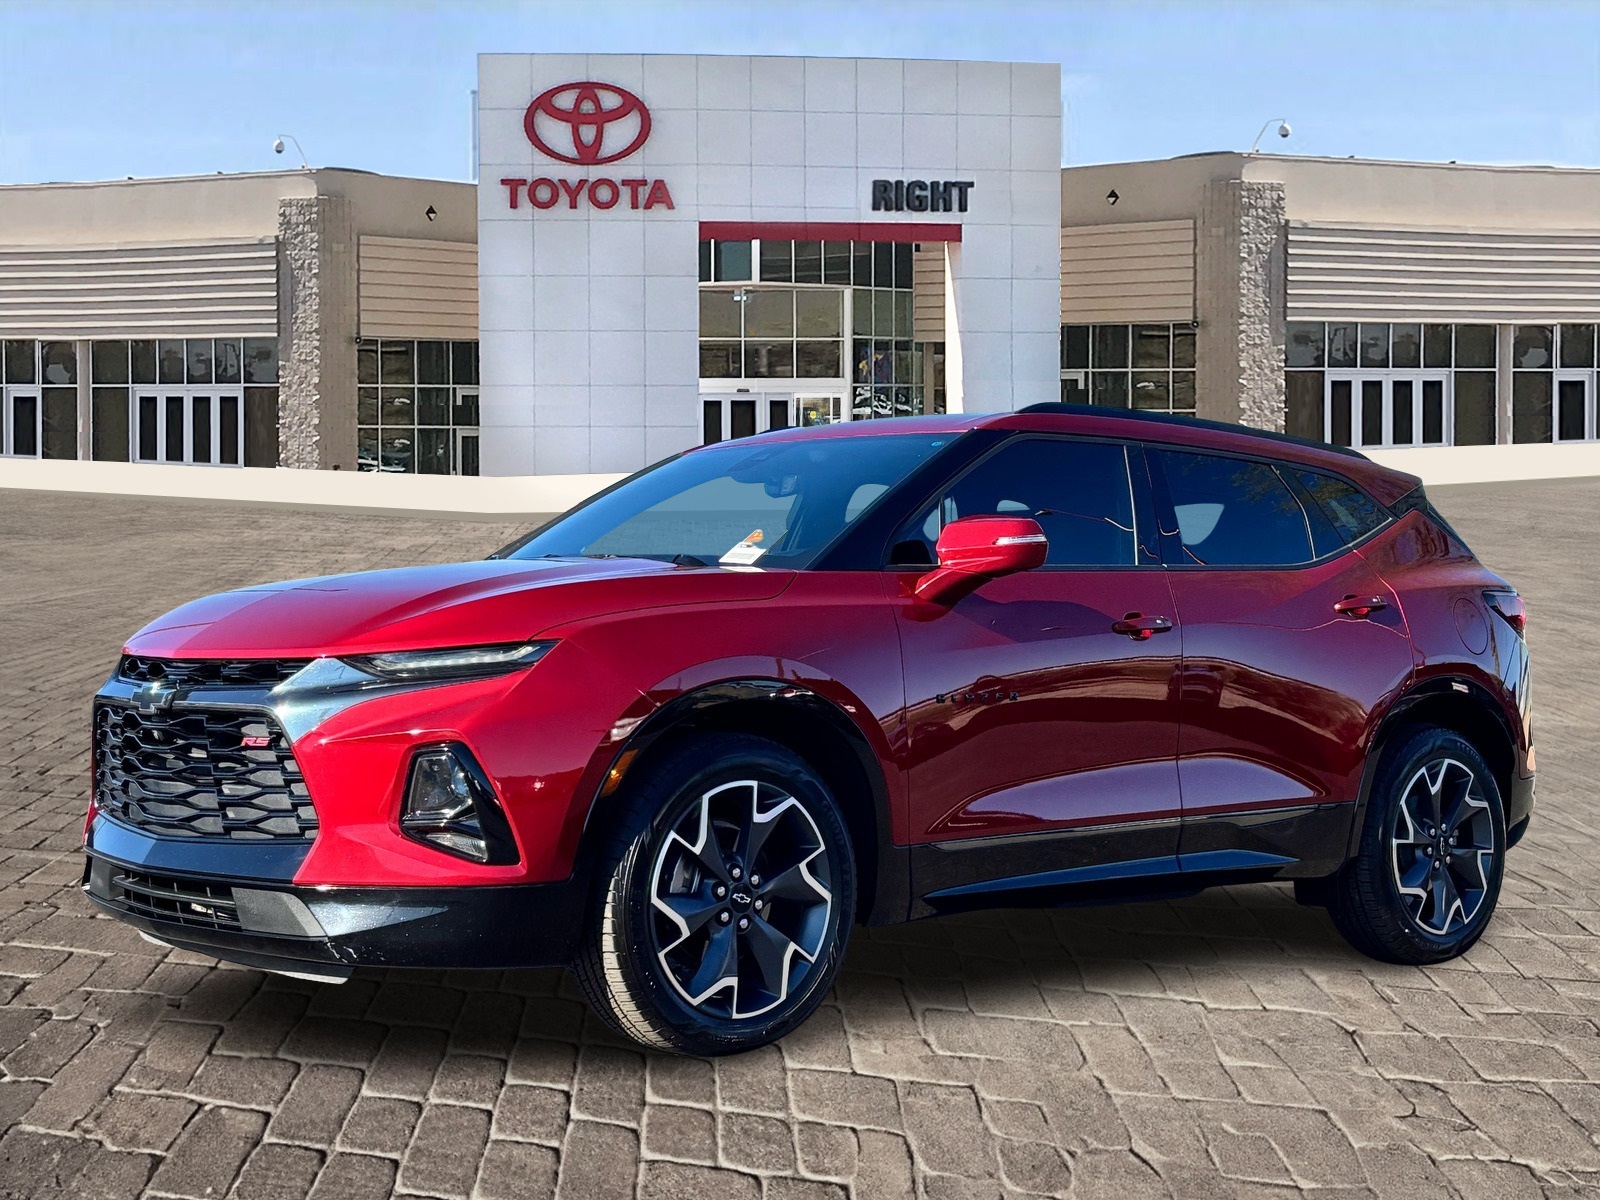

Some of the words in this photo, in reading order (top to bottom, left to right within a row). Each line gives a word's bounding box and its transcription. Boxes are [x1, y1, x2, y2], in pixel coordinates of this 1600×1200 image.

[500, 178, 676, 210] TOYOTA
[872, 179, 975, 212] RIGHT
[240, 737, 271, 747] RS
